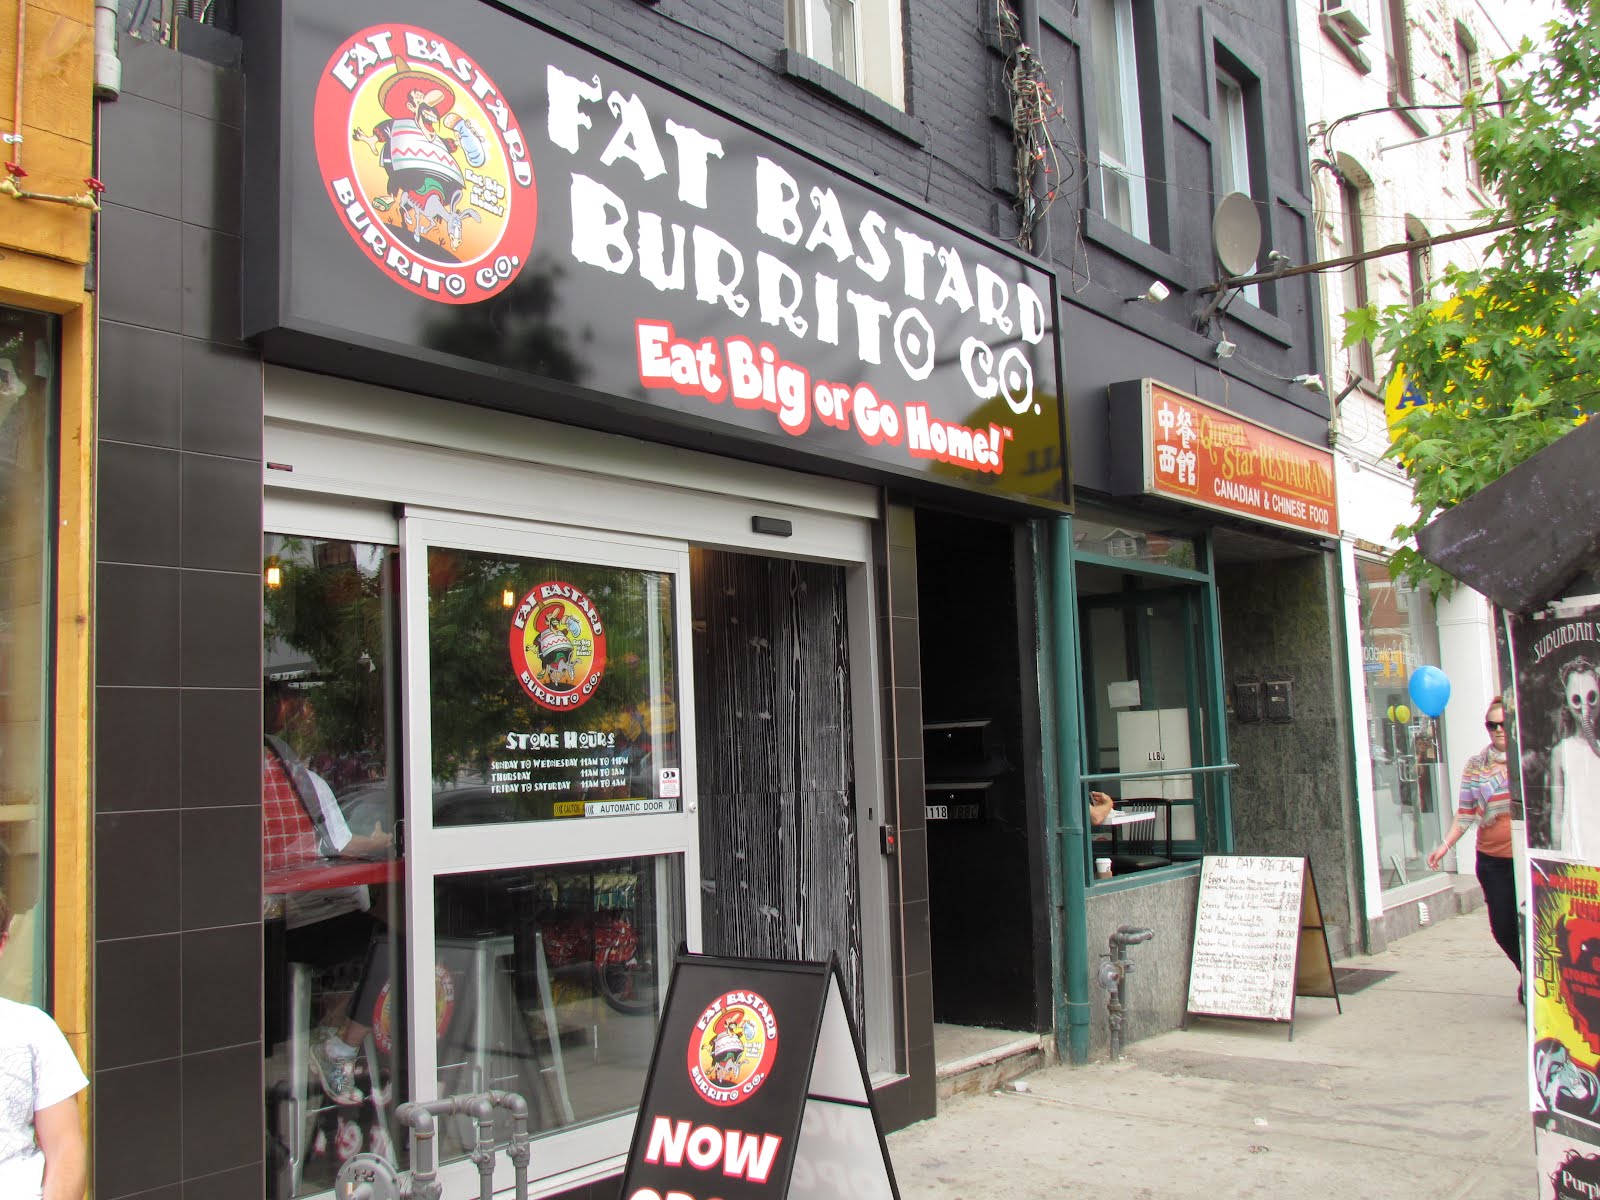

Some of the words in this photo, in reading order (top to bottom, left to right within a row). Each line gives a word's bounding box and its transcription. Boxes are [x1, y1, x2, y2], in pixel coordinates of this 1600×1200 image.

[331, 30, 393, 91] FAT
[404, 31, 532, 187] BASTARD
[546, 64, 725, 209] FAT
[756, 156, 1045, 345] BASTARD
[331, 177, 466, 296] BURRITO
[476, 255, 519, 289] CO.
[571, 172, 935, 381] BURRITO
[960, 335, 1042, 416] CO.
[637, 322, 722, 394] Eat
[727, 339, 806, 427] Big
[815, 383, 850, 420] or
[853, 386, 899, 437] Go
[905, 405, 1000, 466] Home!
[1200, 415, 1245, 465] Queen
[1222, 446, 1259, 480] Star
[1259, 442, 1332, 497] RESTAURANT
[1213, 477, 1260, 507] CANADIAN
[1263, 491, 1270, 510] &
[1272, 494, 1307, 519] CHINESE
[1309, 505, 1329, 525] FOOD
[514, 592, 537, 629] FAT
[540, 584, 602, 635] BASTARD
[1533, 622, 1593, 664] SUBURBAN
[520, 671, 579, 706] BURRITO
[582, 671, 601, 694] CO.
[491, 760, 518, 770] SUNDAY
[521, 760, 531, 769] TO
[533, 758, 578, 768] WEDNESDAY
[579, 757, 598, 767] 11AM
[600, 757, 609, 766] TO
[611, 756, 628, 765] 11PM
[506, 731, 559, 750] STORE
[563, 731, 615, 749] HOURS
[491, 771, 531, 781] THURSDAY
[580, 768, 598, 777] 11AM
[600, 767, 609, 776] TO
[491, 784, 520, 794] FRIDAY
[521, 783, 532, 792] TO
[534, 781, 571, 791] SATURDAY
[580, 779, 598, 788] 11AM
[600, 778, 610, 787] TO
[611, 778, 626, 786] 4AM
[600, 803, 640, 813] AUTOMATIC
[644, 802, 663, 811] DOOR
[1215, 858, 1229, 869] ALL
[1236, 858, 1255, 869] DAY
[1259, 858, 1300, 872] SPECIAL
[697, 999, 722, 1031] FAT
[726, 992, 776, 1039] BASTARD
[691, 1066, 738, 1101] BURRITO
[743, 1072, 765, 1094] CO.
[646, 1117, 779, 1181] NOW
